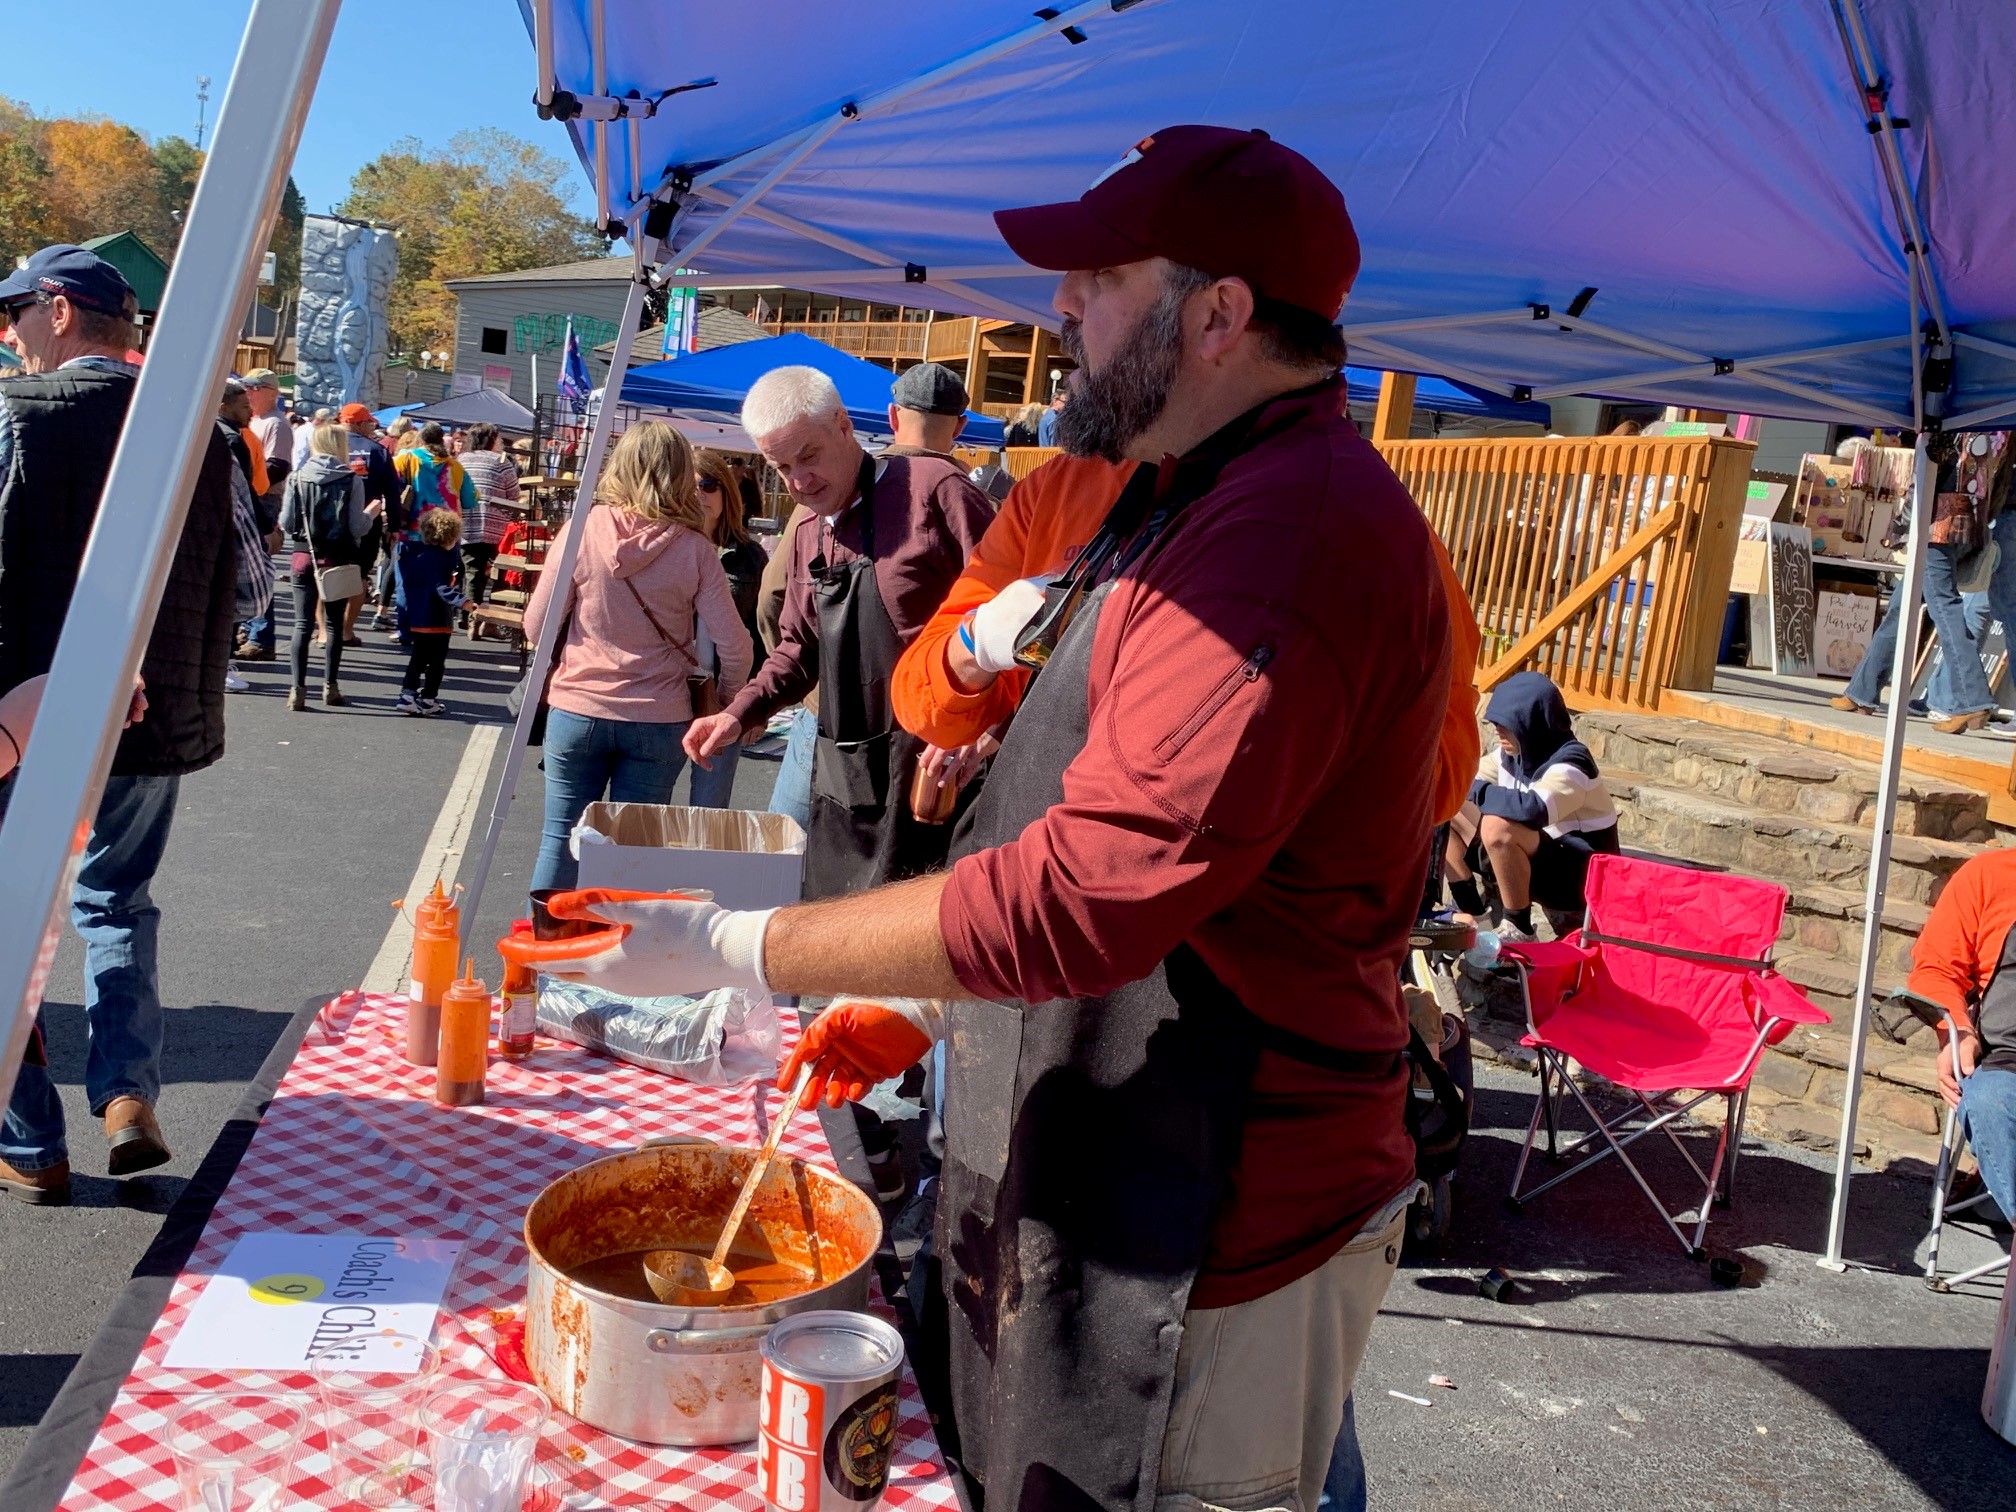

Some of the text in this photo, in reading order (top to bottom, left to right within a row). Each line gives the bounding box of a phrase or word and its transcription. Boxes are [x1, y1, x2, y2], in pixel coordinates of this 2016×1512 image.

[1824, 611, 1868, 633] Harvest
[1830, 594, 1869, 612] Pupkin
[1781, 596, 1811, 658] Knew
[304, 1242, 406, 1360] Coach's Chili
